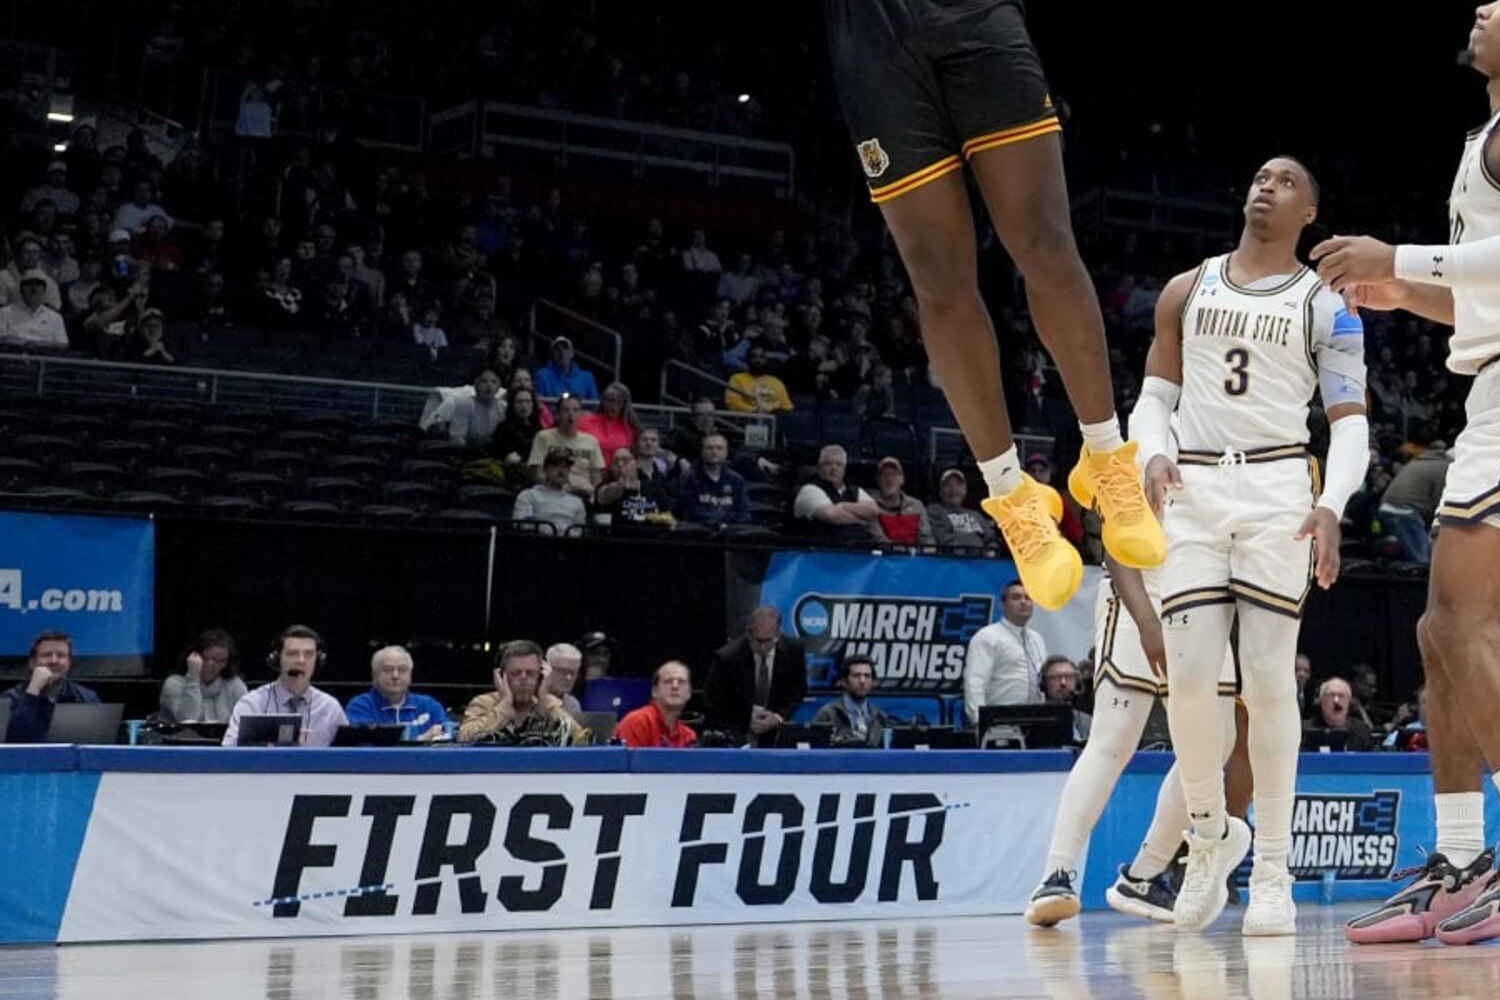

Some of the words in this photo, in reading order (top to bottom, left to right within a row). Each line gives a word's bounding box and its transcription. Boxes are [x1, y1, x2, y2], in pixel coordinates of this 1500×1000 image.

[1253, 315, 1291, 346] STATE
[1224, 348, 1249, 396] 3
[831, 603, 937, 641] MARCH
[845, 642, 966, 680] ADNES
[1293, 800, 1356, 833] ARCH
[272, 793, 648, 919] FIRST
[671, 792, 948, 908] FOUR
